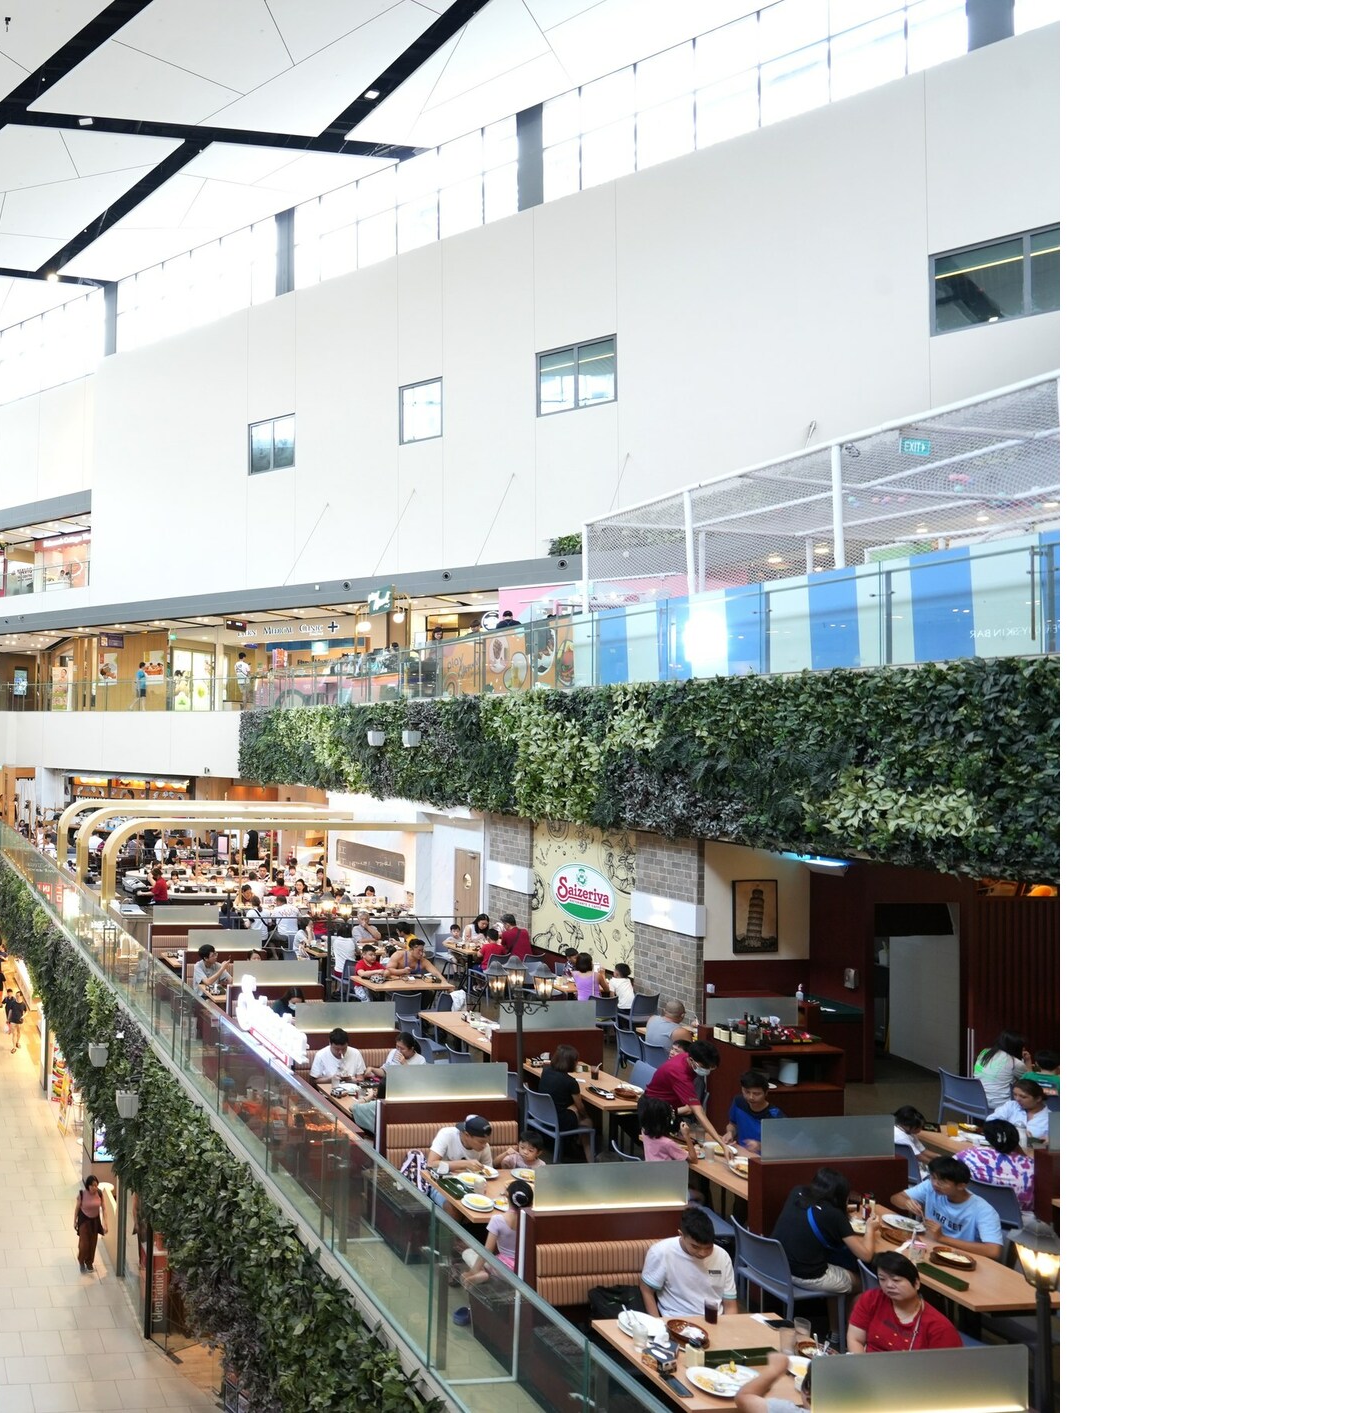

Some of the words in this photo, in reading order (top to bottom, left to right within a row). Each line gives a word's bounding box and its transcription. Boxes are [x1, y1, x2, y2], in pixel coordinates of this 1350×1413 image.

[904, 441, 921, 452] EXIT
[263, 626, 294, 635] MEDICAL
[299, 624, 324, 633] CLINIC
[557, 876, 610, 905] Saizeriya
[152, 1269, 164, 1323] Glenfiddich
